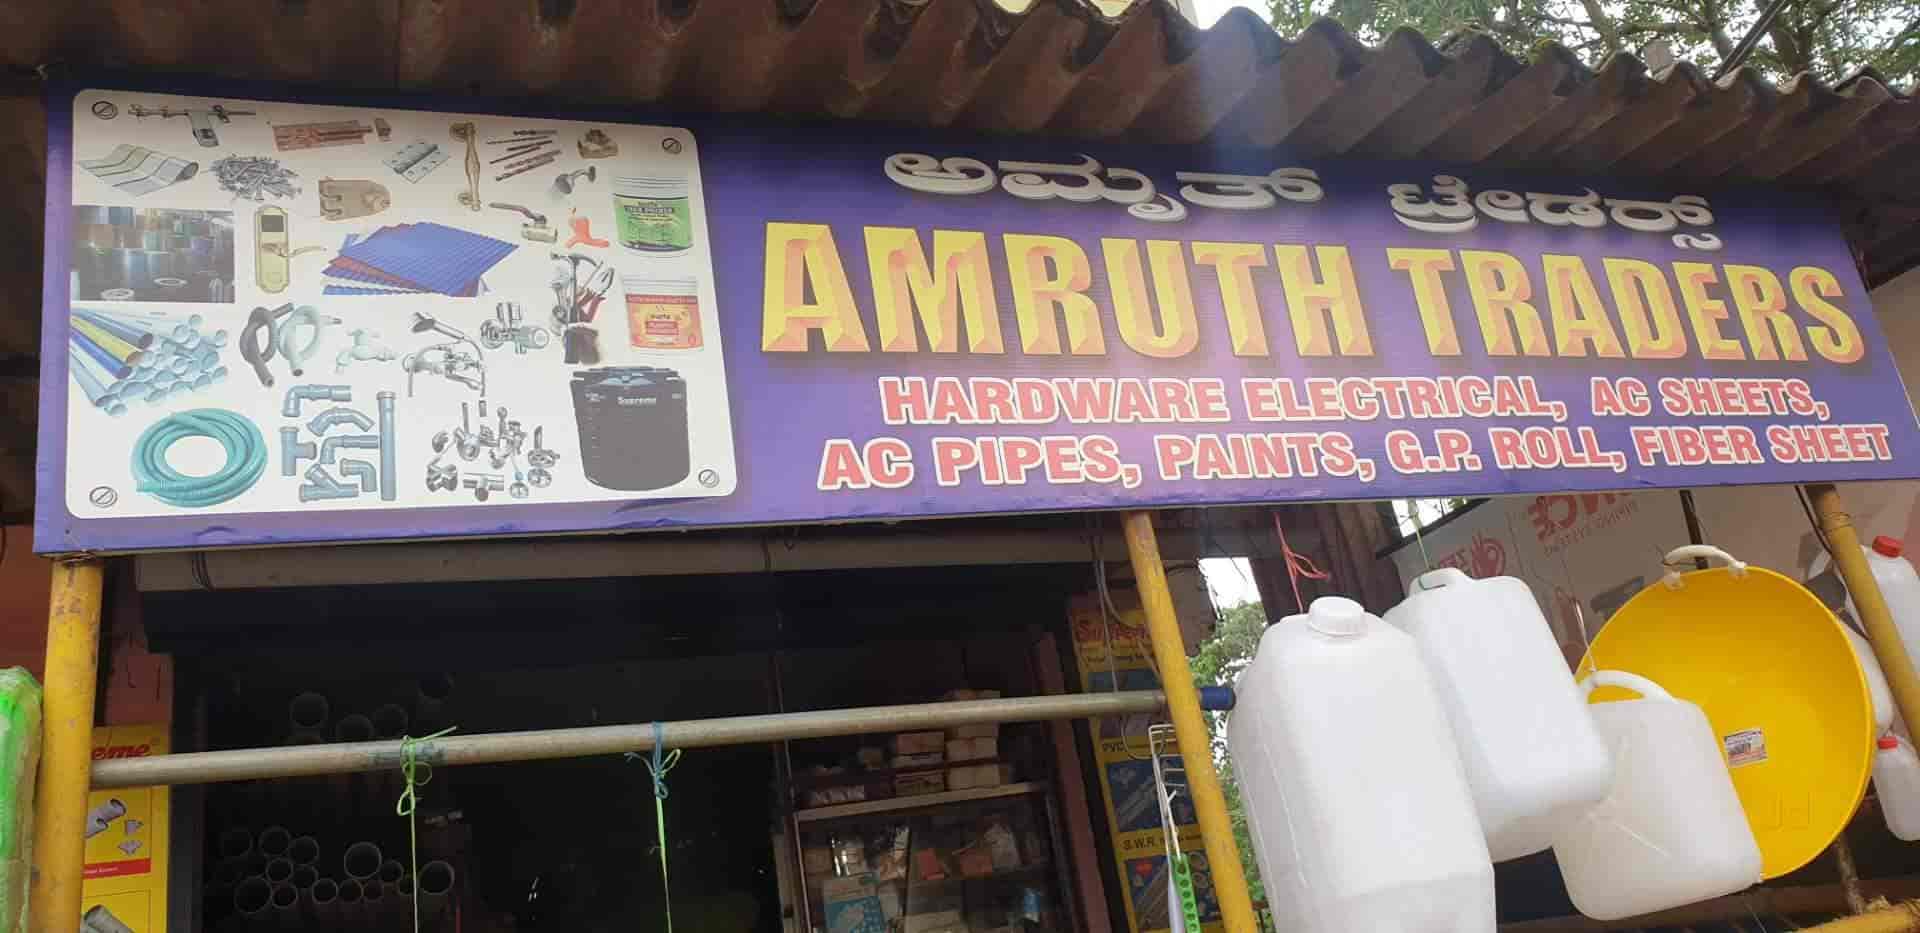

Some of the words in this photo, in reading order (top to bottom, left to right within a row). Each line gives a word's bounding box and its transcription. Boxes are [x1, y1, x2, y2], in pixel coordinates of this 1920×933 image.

[884, 152, 1325, 223] ಅಮೃತ್
[761, 221, 1376, 358] AMRUTH
[1386, 246, 1866, 363] TRADERS
[878, 376, 1230, 425] HARDWARE
[1244, 376, 1568, 422] ELECTRICAL,
[1591, 377, 1649, 416] AC
[1661, 377, 1831, 421] SHEETS,
[816, 439, 914, 490] AC
[931, 436, 1142, 488] PIPES,
[1153, 433, 1376, 482] PAINTS,
[1385, 430, 1483, 474] G.P.
[1490, 427, 1627, 471] ROLL,
[1632, 427, 1762, 465] FIBER
[1768, 424, 1894, 462] SHEET
